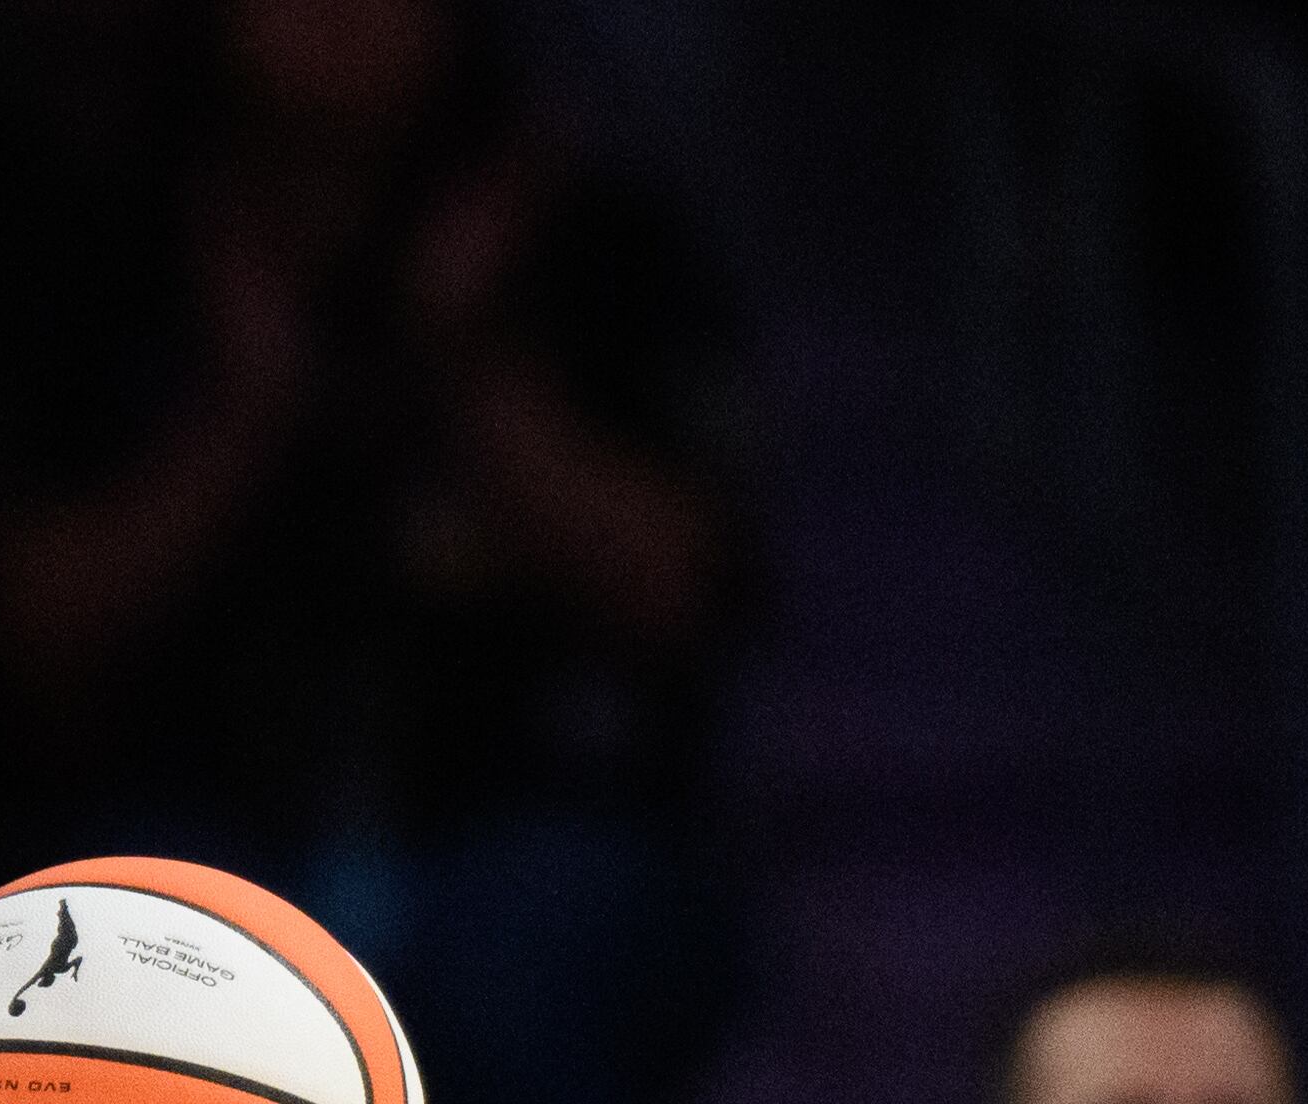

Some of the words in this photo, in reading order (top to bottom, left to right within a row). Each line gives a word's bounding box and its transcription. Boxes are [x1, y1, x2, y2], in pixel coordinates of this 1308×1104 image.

[117, 935, 170, 956] BALL
[125, 950, 217, 987] OFFICIAL
[174, 950, 235, 981] GAME
[28, 1080, 71, 1093] EVO
